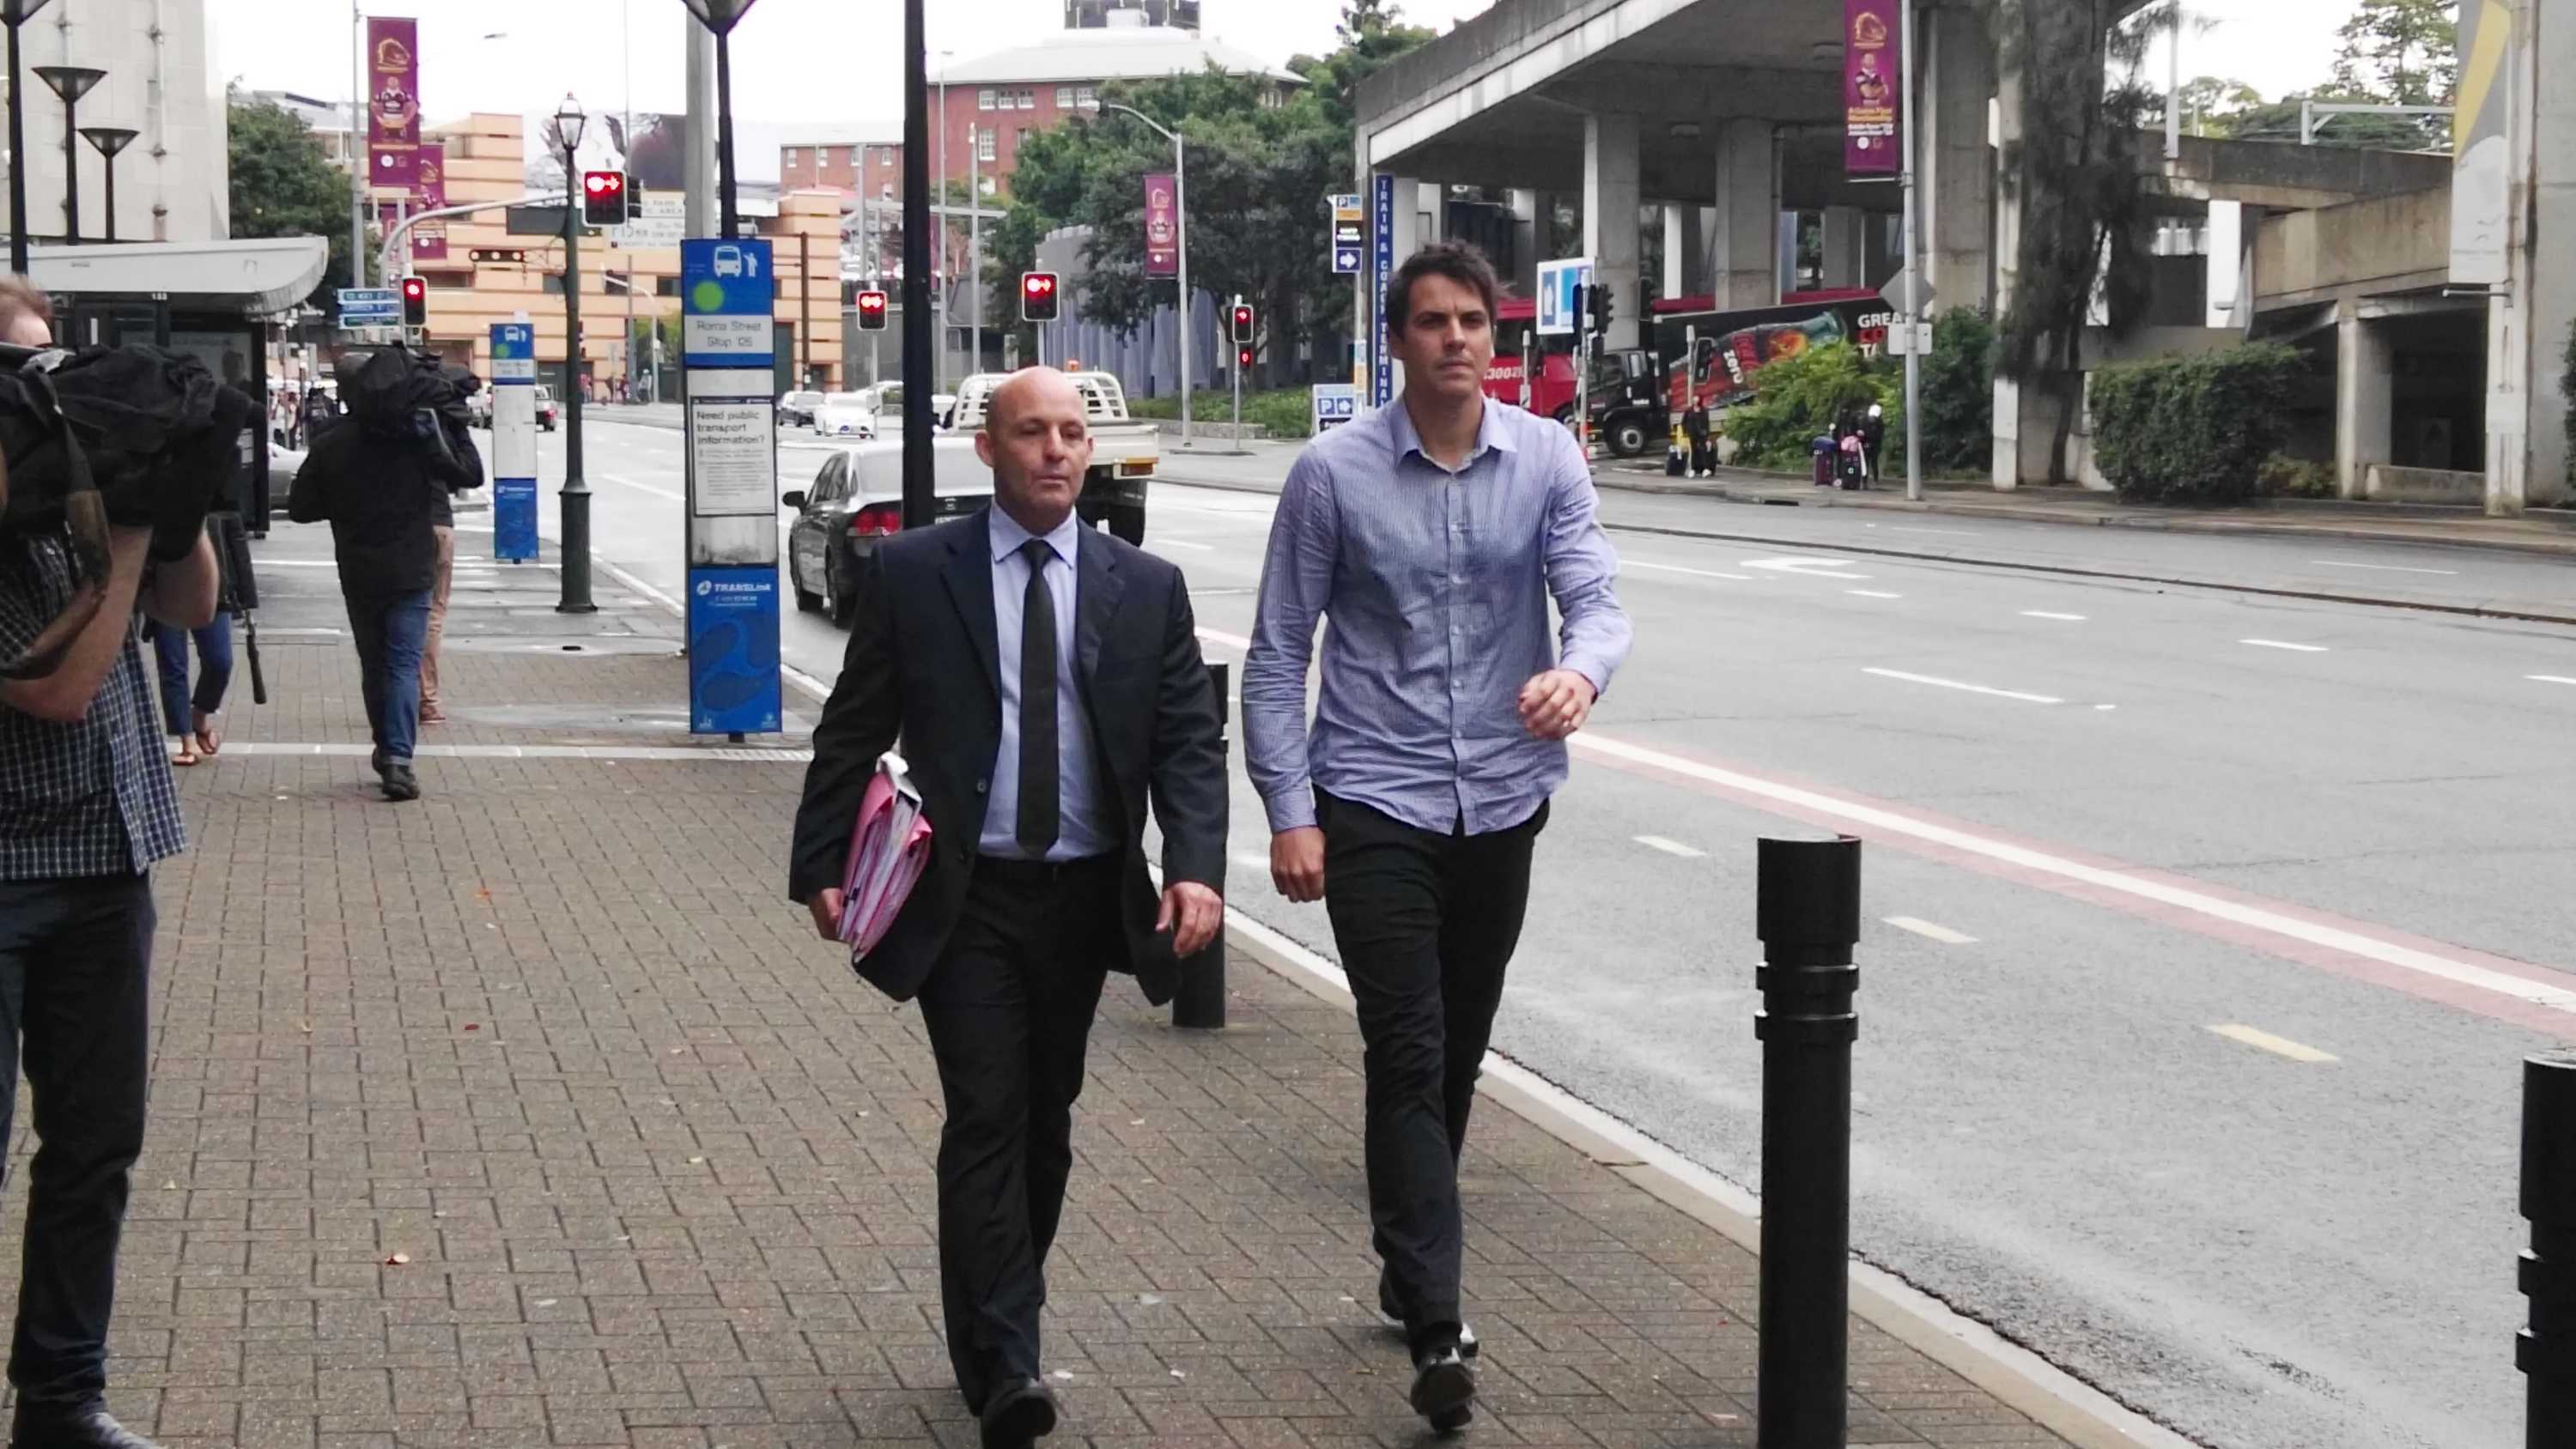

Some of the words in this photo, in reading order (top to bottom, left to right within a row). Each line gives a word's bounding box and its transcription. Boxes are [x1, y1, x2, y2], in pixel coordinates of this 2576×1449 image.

[1380, 179, 1388, 234] TRAIN
[696, 321, 727, 330] Roma
[731, 321, 762, 330] Street
[1857, 312, 1902, 328] GREA
[707, 336, 732, 348] Stop
[1321, 399, 1333, 414] P
[696, 410, 725, 421] Need
[728, 409, 760, 422] public
[696, 423, 747, 434] transport
[697, 434, 765, 446] information?
